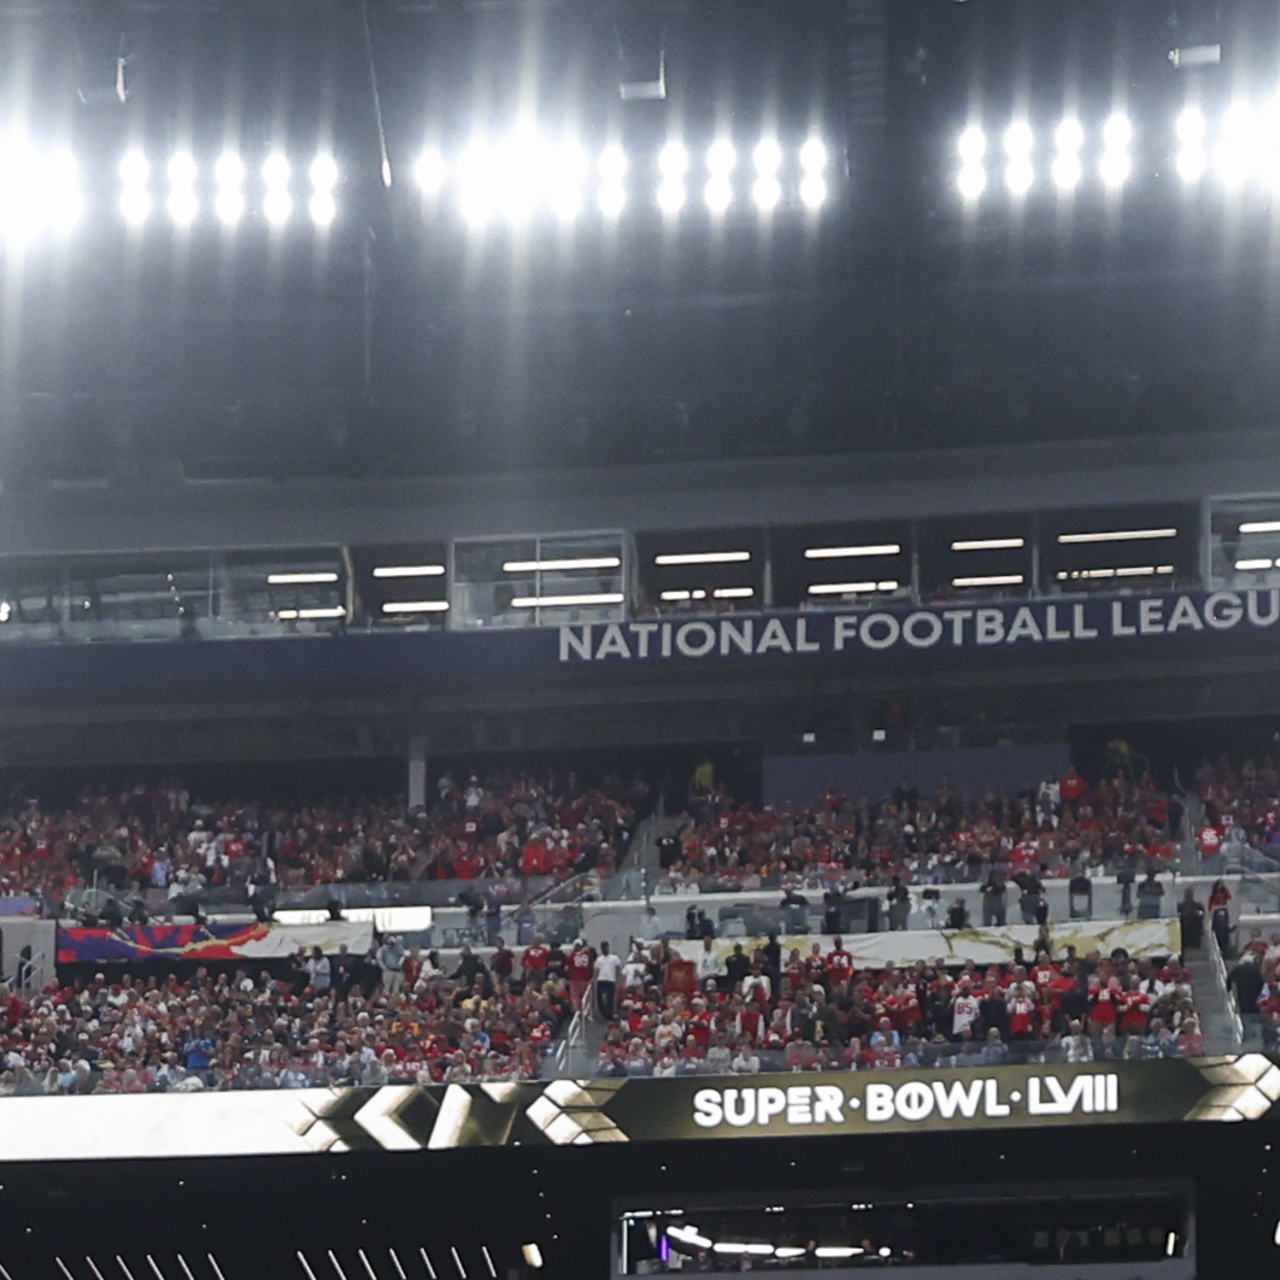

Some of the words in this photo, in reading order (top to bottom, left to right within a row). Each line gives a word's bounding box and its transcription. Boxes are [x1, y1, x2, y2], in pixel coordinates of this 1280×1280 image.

[557, 617, 819, 661] NATIONAL
[833, 606, 1098, 651] FOOTBALL
[692, 1086, 845, 1128] SUPER
[866, 1079, 1011, 1122] BOWL
[1029, 1074, 1119, 1115] LVIII
